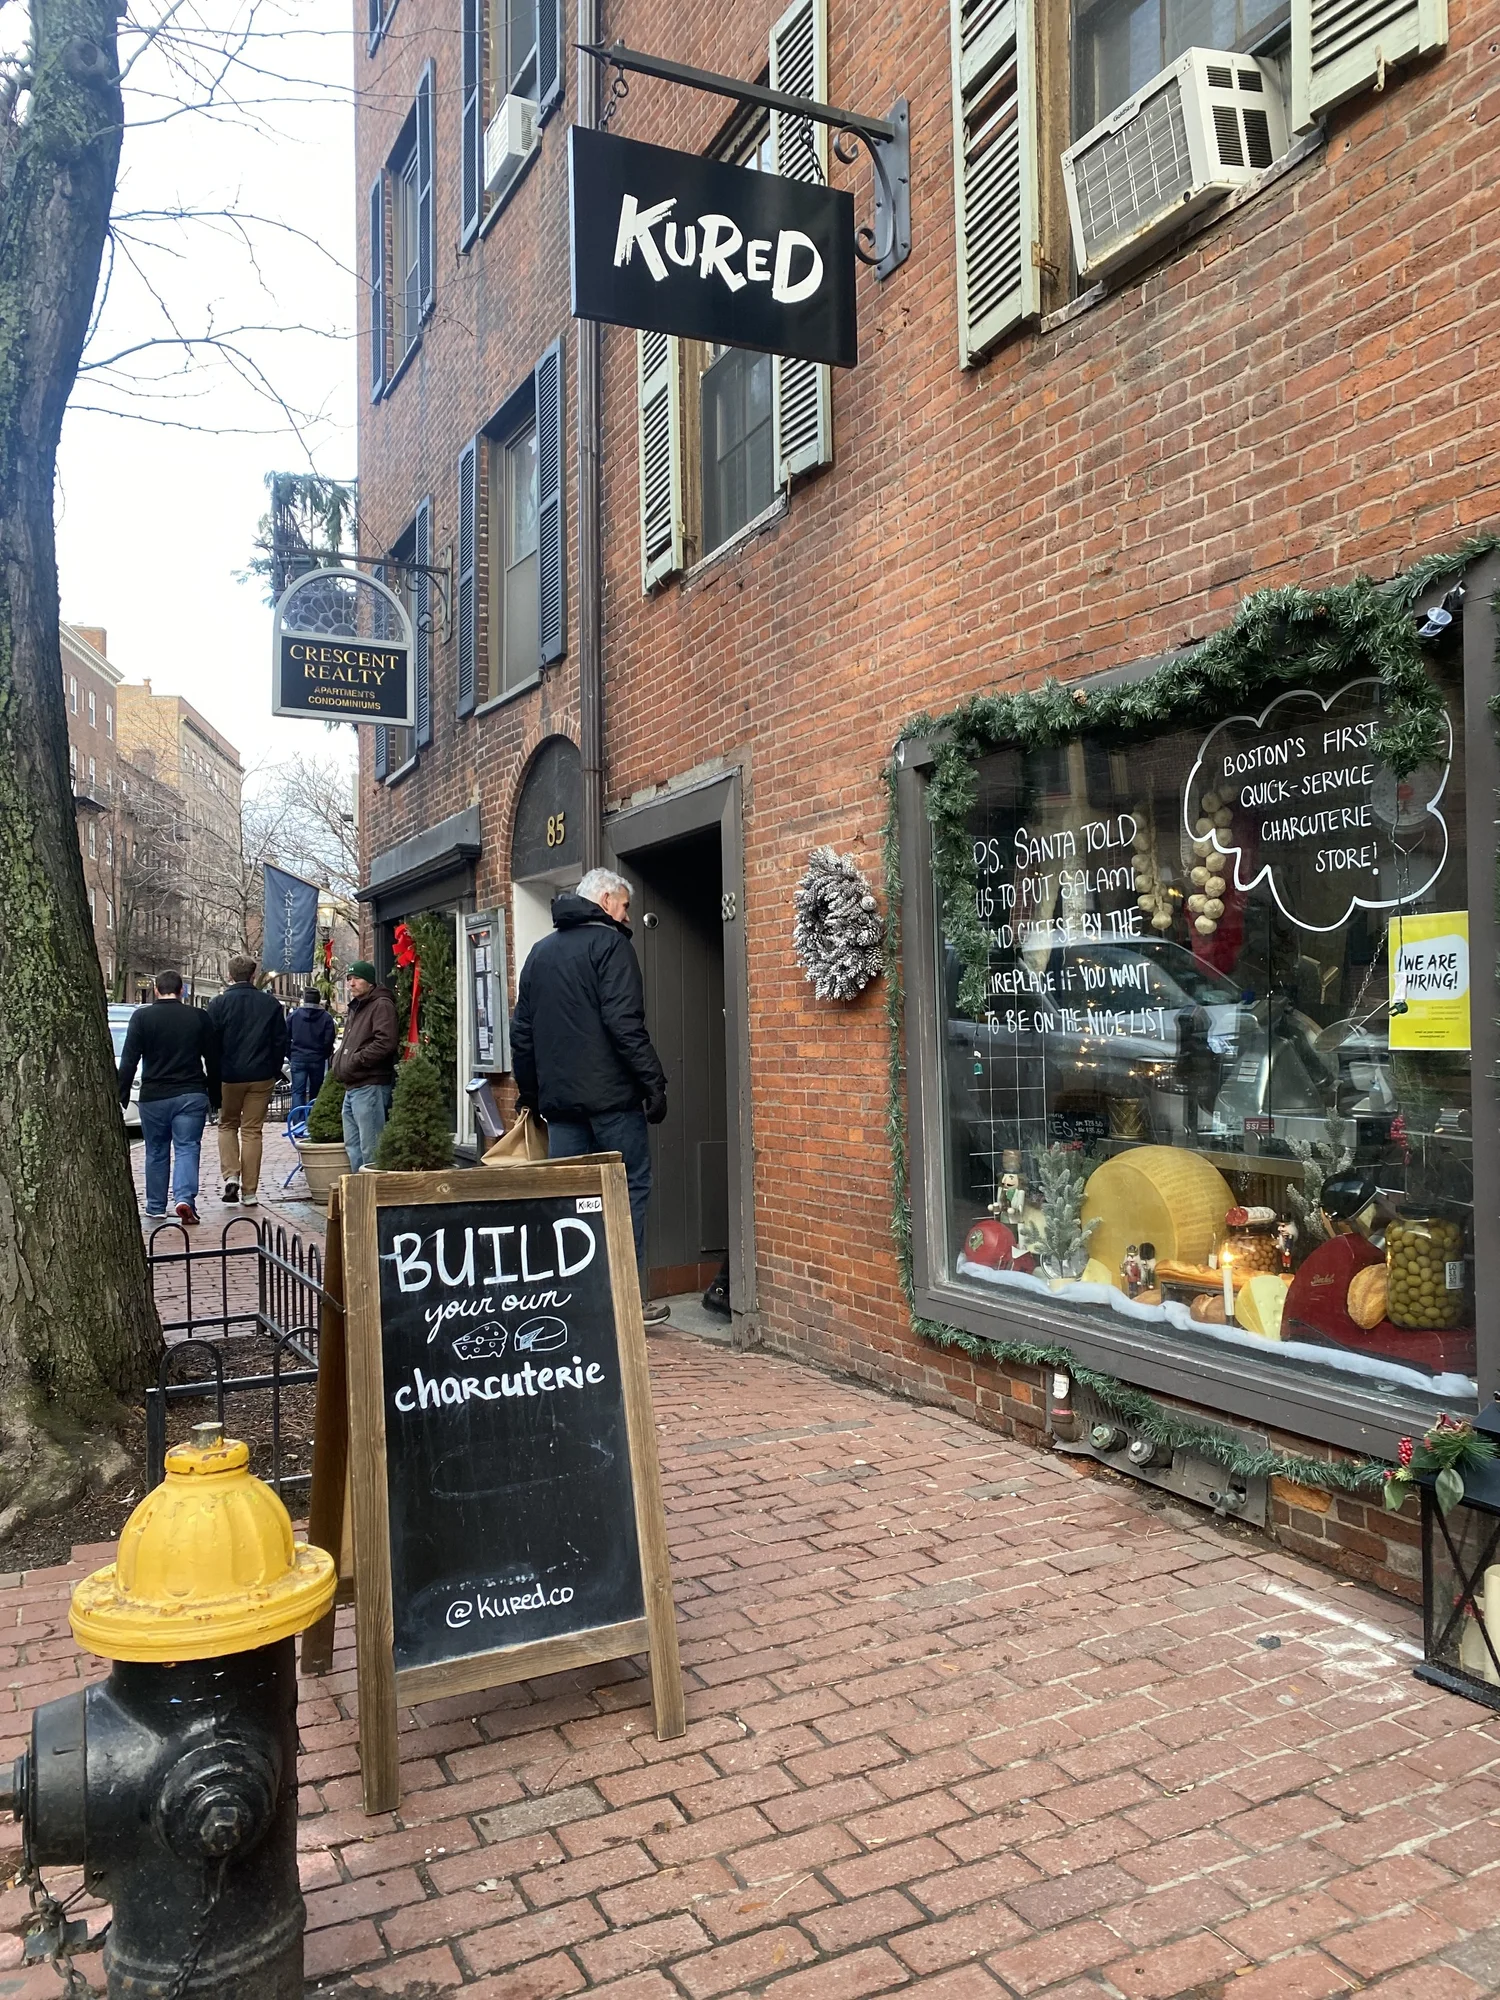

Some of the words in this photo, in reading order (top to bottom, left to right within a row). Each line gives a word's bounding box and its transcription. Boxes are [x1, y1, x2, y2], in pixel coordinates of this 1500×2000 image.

[613, 193, 824, 304] KURED
[289, 644, 399, 670] CRESCENT
[304, 663, 386, 686] REALTY
[308, 695, 381, 710] CONDOMINIUMS
[314, 686, 375, 699] APARTMENTS
[1223, 737, 1306, 777] BOSTON'S
[1323, 721, 1379, 754] FIRST
[1240, 764, 1375, 808] QUICK-SERVICE
[547, 811, 565, 847] 85
[1261, 804, 1373, 841] CHARCUTERIE
[1014, 827, 1076, 869] SANTA
[1080, 814, 1137, 853] TOLD
[1315, 841, 1379, 875] STORE!
[975, 888, 994, 918] US
[998, 883, 1017, 910] TO
[1022, 873, 1054, 907] PUT
[1059, 866, 1136, 899] SALAMI
[284, 889, 294, 965] ANTIQUES
[989, 924, 1013, 949] ND
[1080, 912, 1102, 940] BY
[1106, 905, 1143, 940] THE
[983, 969, 1056, 999] IREPLACE
[1061, 966, 1077, 991] IF
[1079, 964, 1106, 992] YOU
[1109, 962, 1150, 995] WANT
[1403, 954, 1424, 971] WE
[1427, 953, 1457, 971] ARE
[1406, 971, 1458, 992] HIRING!
[1005, 1008, 1030, 1033] BE
[1034, 1009, 1054, 1034] ON
[1058, 1008, 1083, 1036] THE
[1088, 1008, 1127, 1037] NICE
[1130, 1006, 1165, 1040] LIST
[390, 1217, 597, 1293] BUILD
[424, 1295, 496, 1344] your
[501, 1289, 573, 1311] own
[394, 1355, 606, 1413] charcuterie
